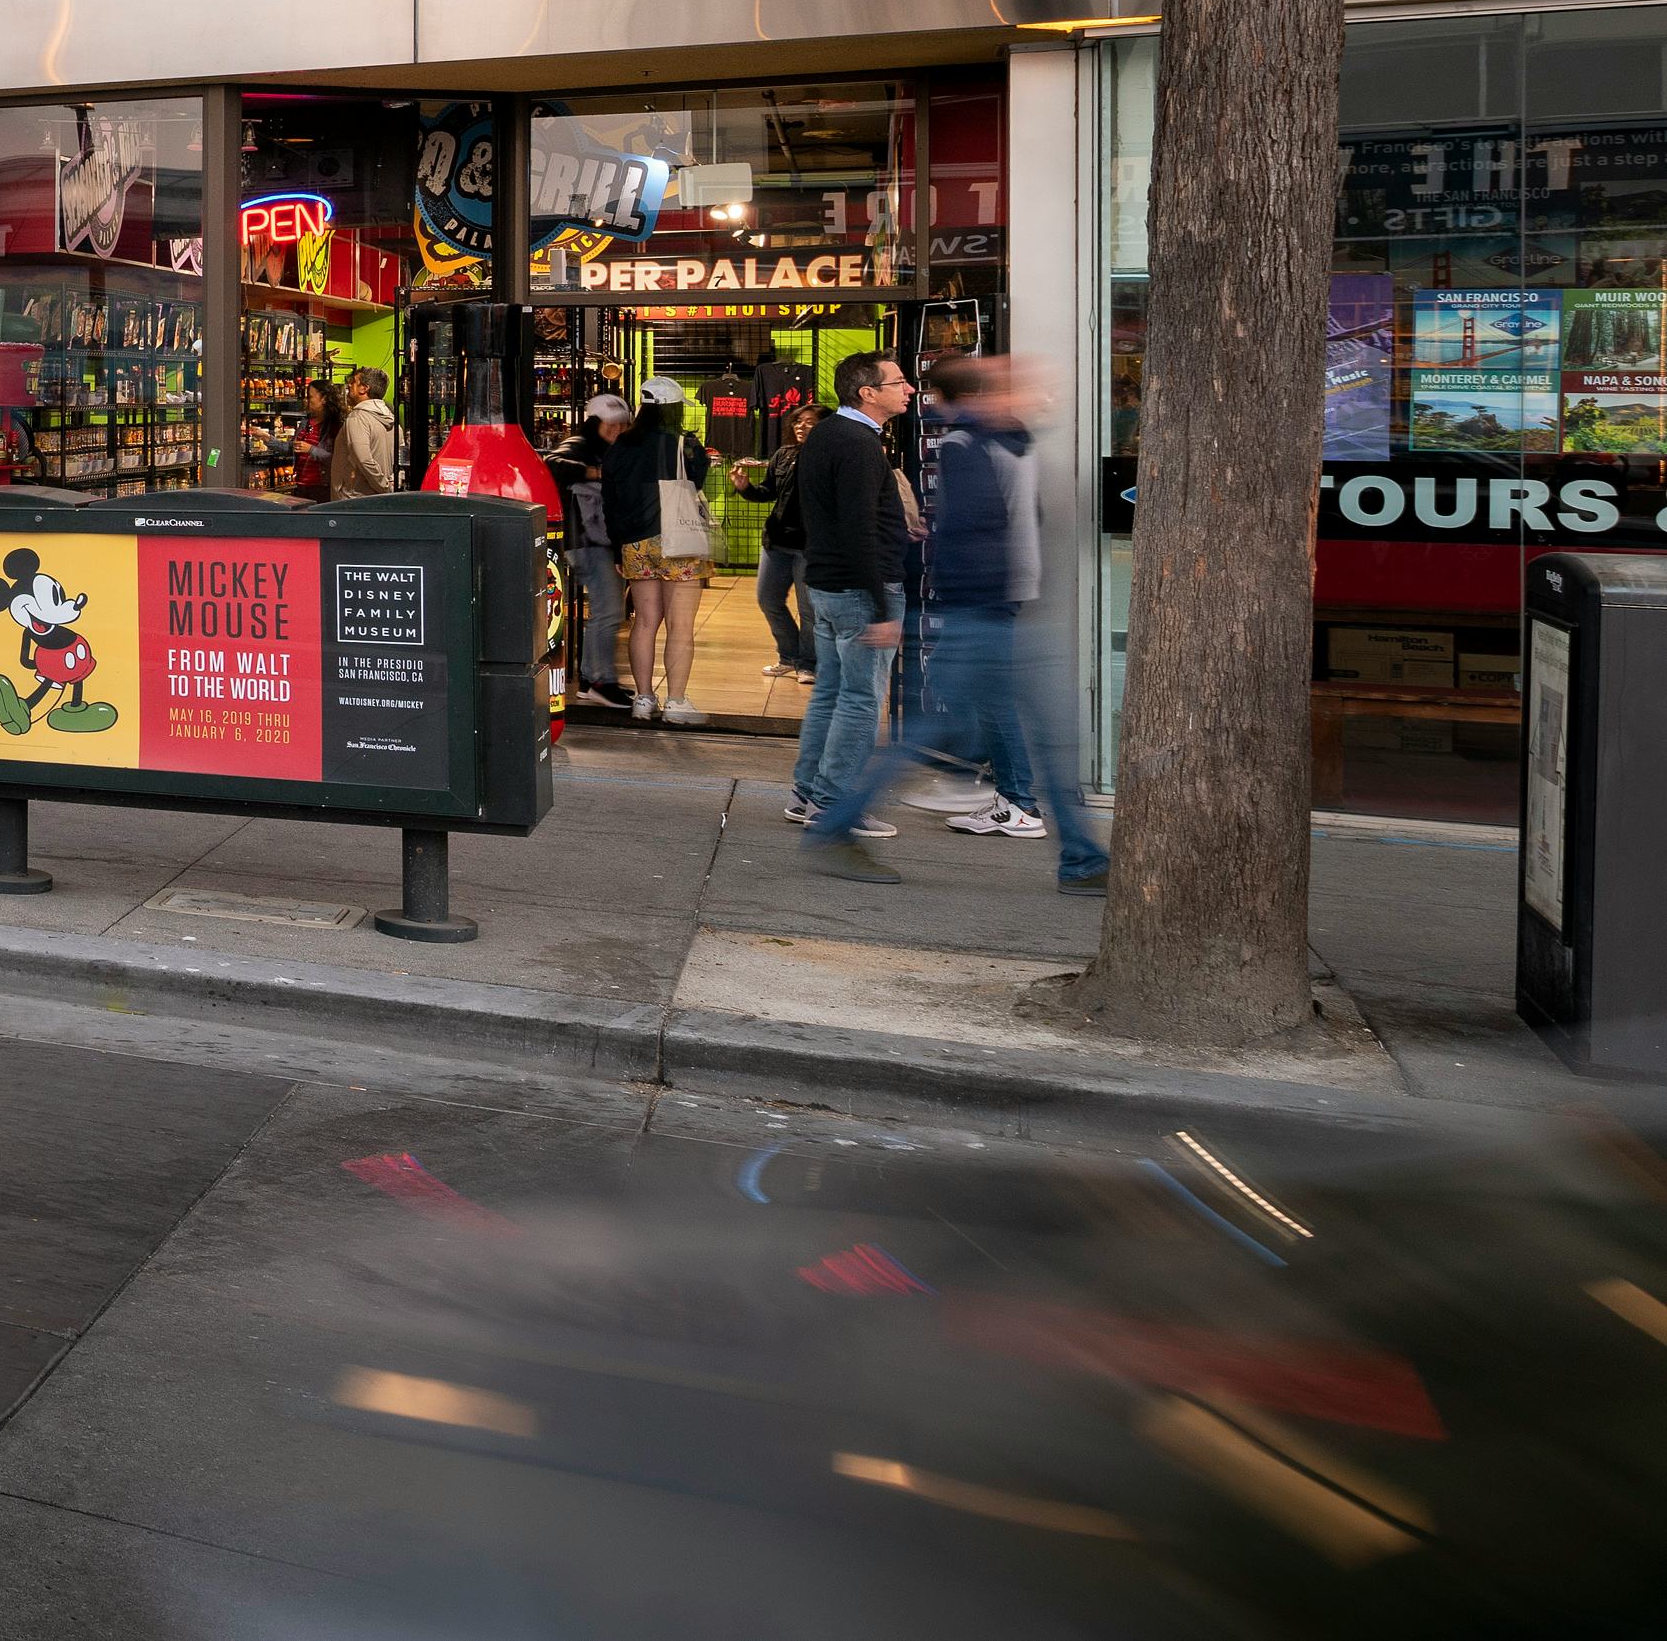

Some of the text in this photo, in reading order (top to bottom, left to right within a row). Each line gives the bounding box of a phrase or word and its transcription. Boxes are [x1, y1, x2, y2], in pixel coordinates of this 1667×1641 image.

[1360, 137, 1471, 155] Francisco's
[1473, 138, 1508, 153] top
[1516, 131, 1628, 149] attractions
[1401, 158, 1508, 174] attractions
[1516, 157, 1546, 169] are
[1551, 155, 1590, 171] just
[1596, 155, 1608, 166] a
[1613, 152, 1659, 170] step
[1415, 187, 1550, 203] THE SAN FRANCISCO
[241, 202, 326, 246] PEN
[677, 255, 863, 291] PALACE
[1437, 292, 1539, 303] SAN FRANCISCO
[1595, 292, 1667, 303] MUIR WOO
[1420, 374, 1552, 386] MONTEREY & CARMEL
[1583, 376, 1618, 386] NAPA
[1622, 376, 1632, 386] &
[168, 560, 289, 600] MICKEY
[344, 572, 415, 582] THE WALT
[344, 589, 415, 601] DISNEY
[169, 600, 289, 640] MOUSE
[344, 608, 415, 619] FAMILY
[344, 626, 416, 638] MUSEUM
[1367, 634, 1428, 645] Hamilton
[1402, 643, 1445, 652] Beach
[168, 649, 291, 676] FROM WALT
[338, 657, 424, 671] IN THE PRESIDIO
[338, 668, 424, 683] SAN FRANCISCO, CA
[1477, 672, 1514, 685] COPY
[168, 675, 291, 702] TO THE WORLD
[338, 697, 424, 709] WALTDISNEY.ORG/MICKEY
[169, 708, 290, 728] MAY 16, 2019 THRU
[169, 724, 290, 744] JANUARY 6, 2020
[346, 741, 416, 753] San Francisco Chronicle
